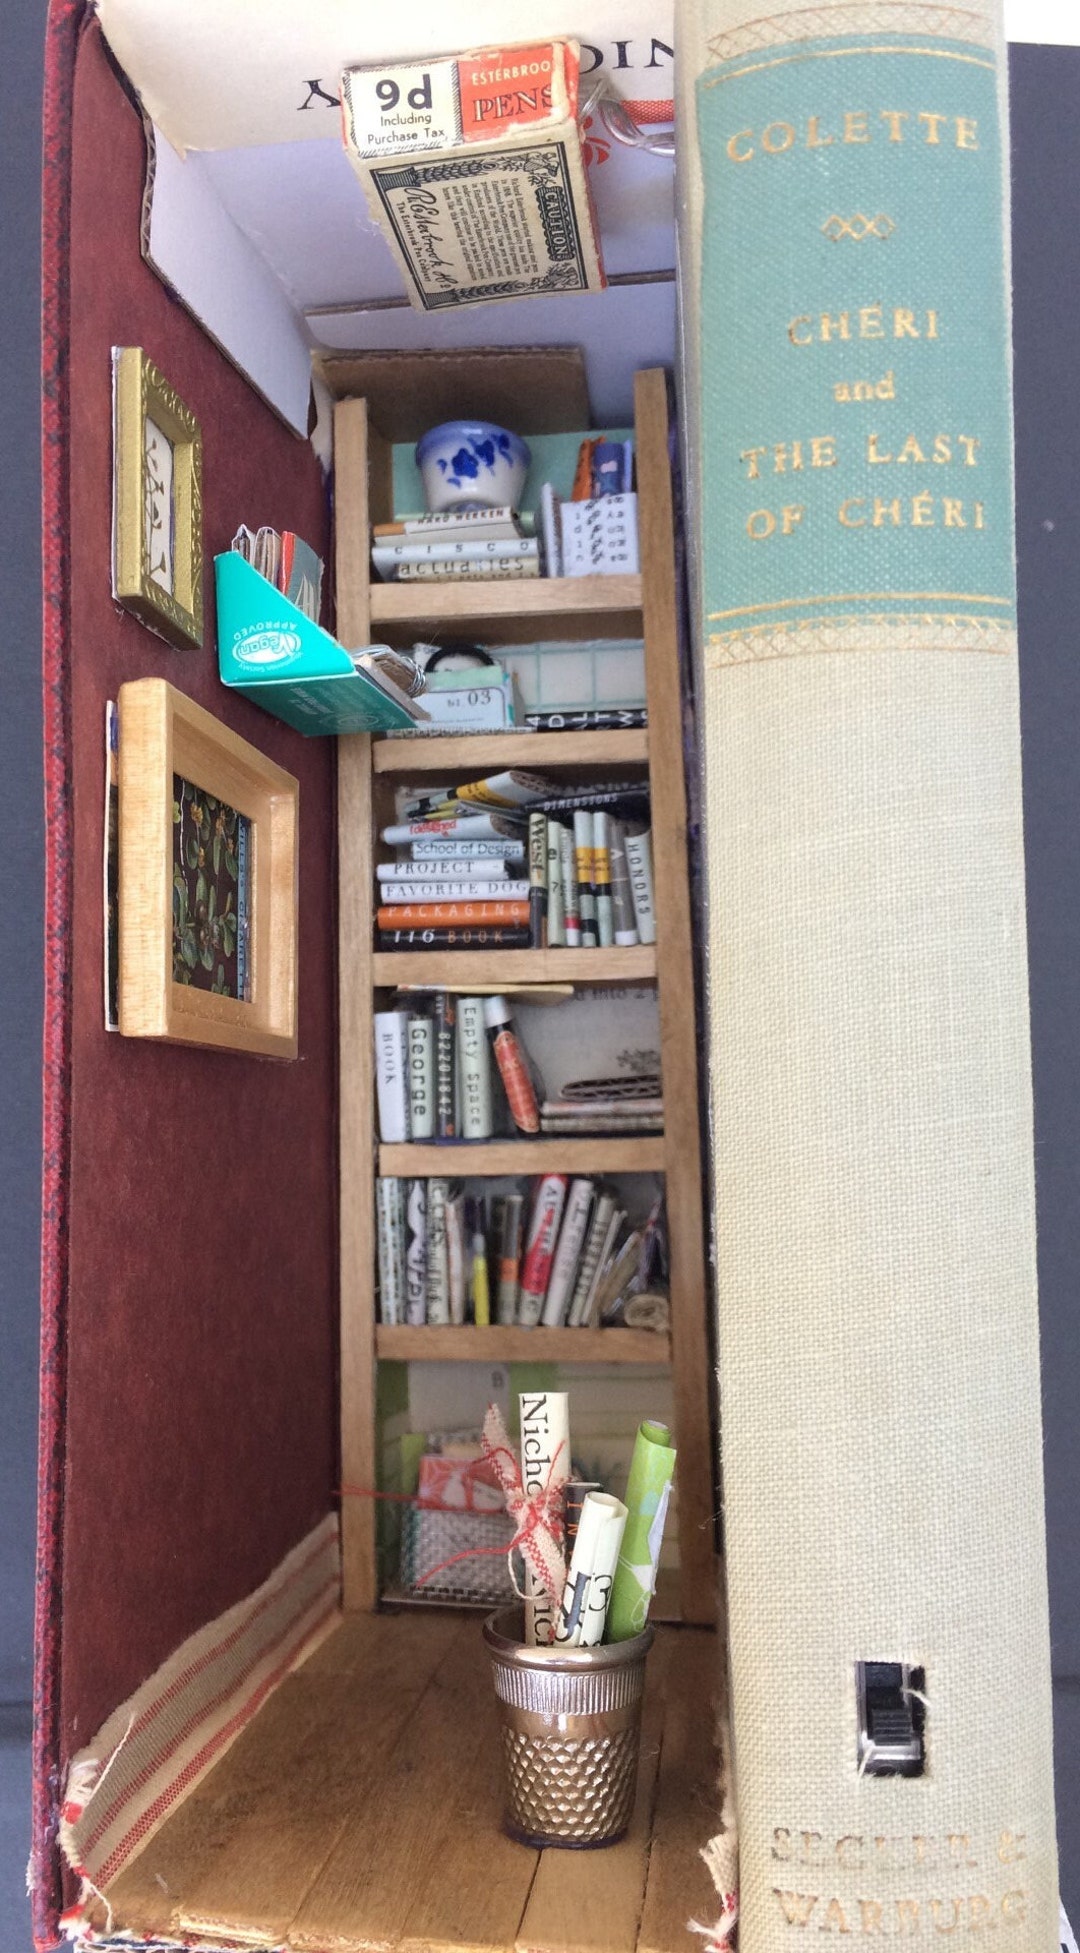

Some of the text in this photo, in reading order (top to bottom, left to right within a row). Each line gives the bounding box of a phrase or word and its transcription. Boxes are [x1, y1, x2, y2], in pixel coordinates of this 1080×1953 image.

[471, 60, 551, 86] ESTERBROO
[376, 74, 432, 111] 9d
[473, 83, 552, 122] PENS
[381, 112, 432, 127] Including
[367, 131, 418, 145] Purchase
[727, 110, 980, 163] COLETTE
[833, 372, 896, 404] and
[740, 434, 981, 480] THE LAST
[746, 489, 986, 541] OF CHÉRI
[233, 621, 297, 641] APPROVED
[416, 843, 520, 857] School of Design
[394, 861, 475, 875] PROJECT
[627, 843, 651, 915] HONORS
[386, 881, 527, 897] FAVORITE DOG
[388, 904, 520, 917] PACKAGING
[447, 931, 504, 943] BOOK
[382, 1032, 396, 1085] BOOK
[411, 1027, 428, 1117] George
[463, 1006, 481, 1126] Empty Space
